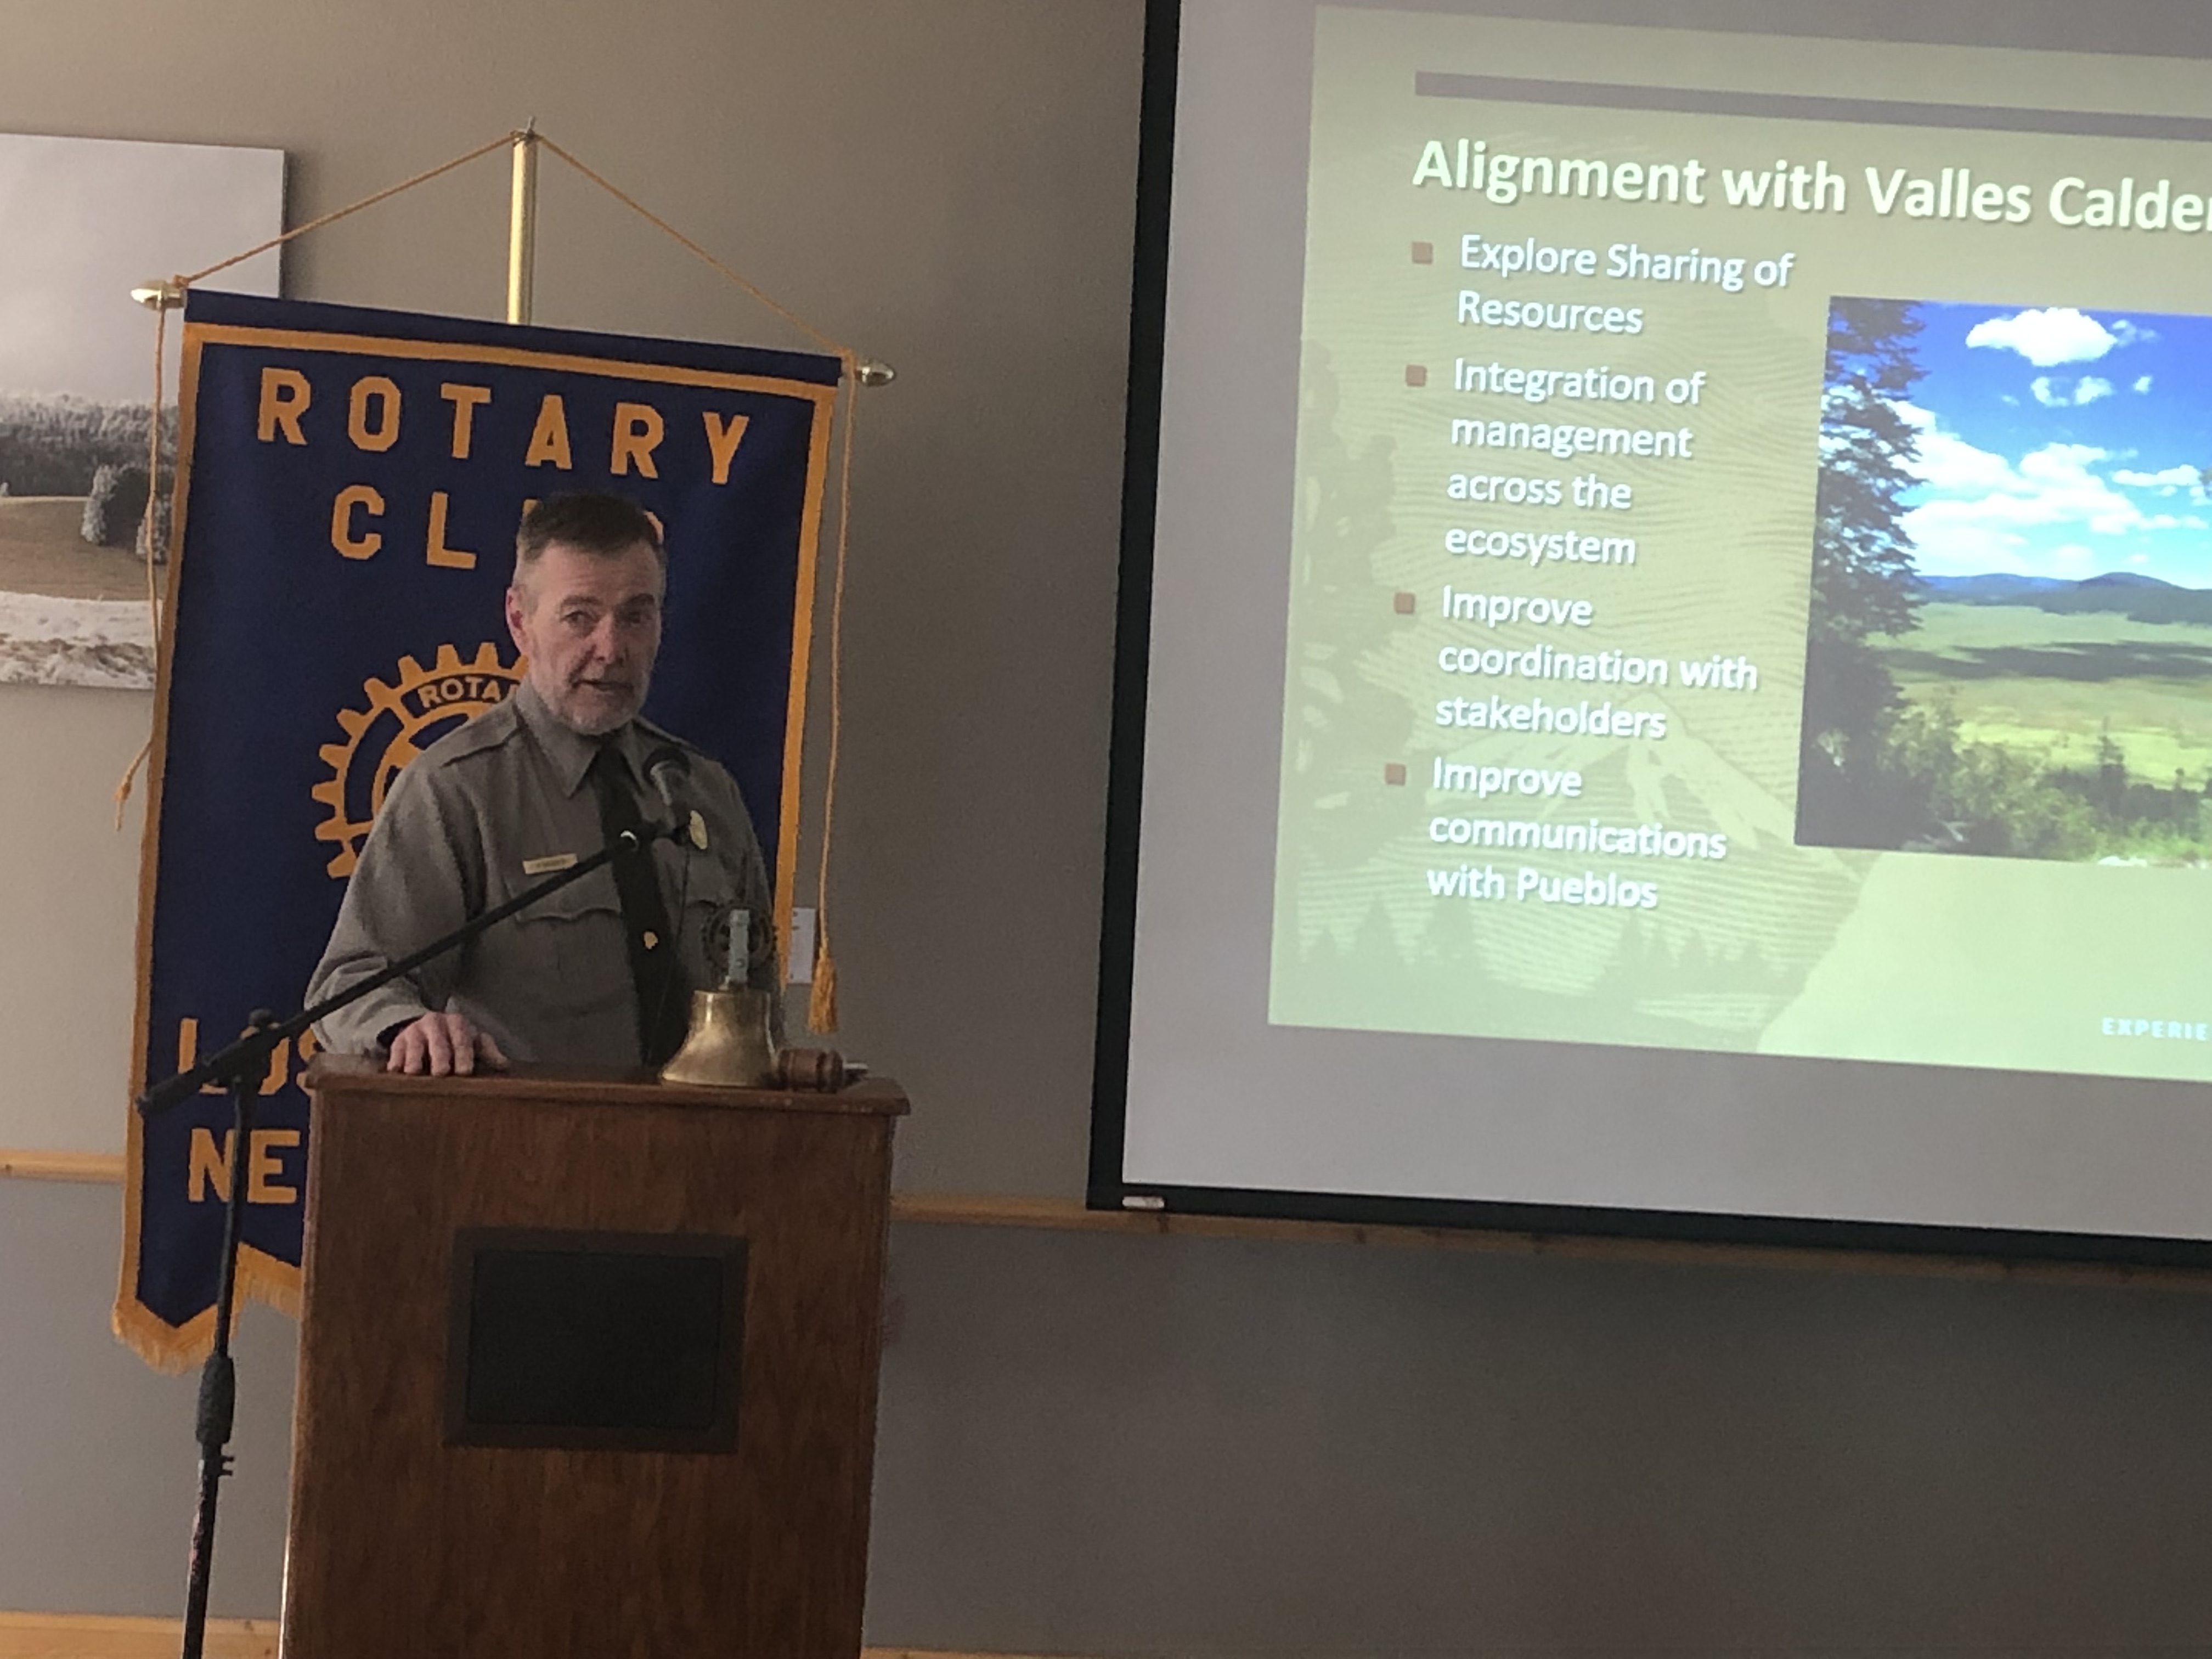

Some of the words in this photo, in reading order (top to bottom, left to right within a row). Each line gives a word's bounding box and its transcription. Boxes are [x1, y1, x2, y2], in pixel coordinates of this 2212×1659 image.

[1412, 137, 1706, 204] Alignment
[1722, 159, 1847, 212] with
[1865, 167, 2032, 223] Valles
[2049, 176, 2212, 232] Calde
[1460, 234, 1596, 278] Explore
[1606, 244, 1745, 291] Sharing
[1753, 252, 1795, 287] of
[1457, 290, 1644, 335] Resources
[1454, 358, 1655, 403] Integration
[1664, 371, 1706, 406] of
[257, 366, 749, 485] ROTARY
[1451, 417, 1693, 460] management
[1447, 472, 1562, 505] across
[1572, 473, 1633, 509] the
[331, 483, 664, 569] CL
[1444, 527, 1636, 567] ecosystem
[1442, 585, 1593, 628] Improve
[1438, 644, 1668, 686] coordination
[1679, 655, 1759, 690] with
[1435, 695, 1667, 738] stakeholders
[1433, 757, 1582, 798] Improve
[1429, 816, 1727, 859] communications
[1426, 865, 1505, 900] with
[1516, 867, 1658, 908] Pueblos
